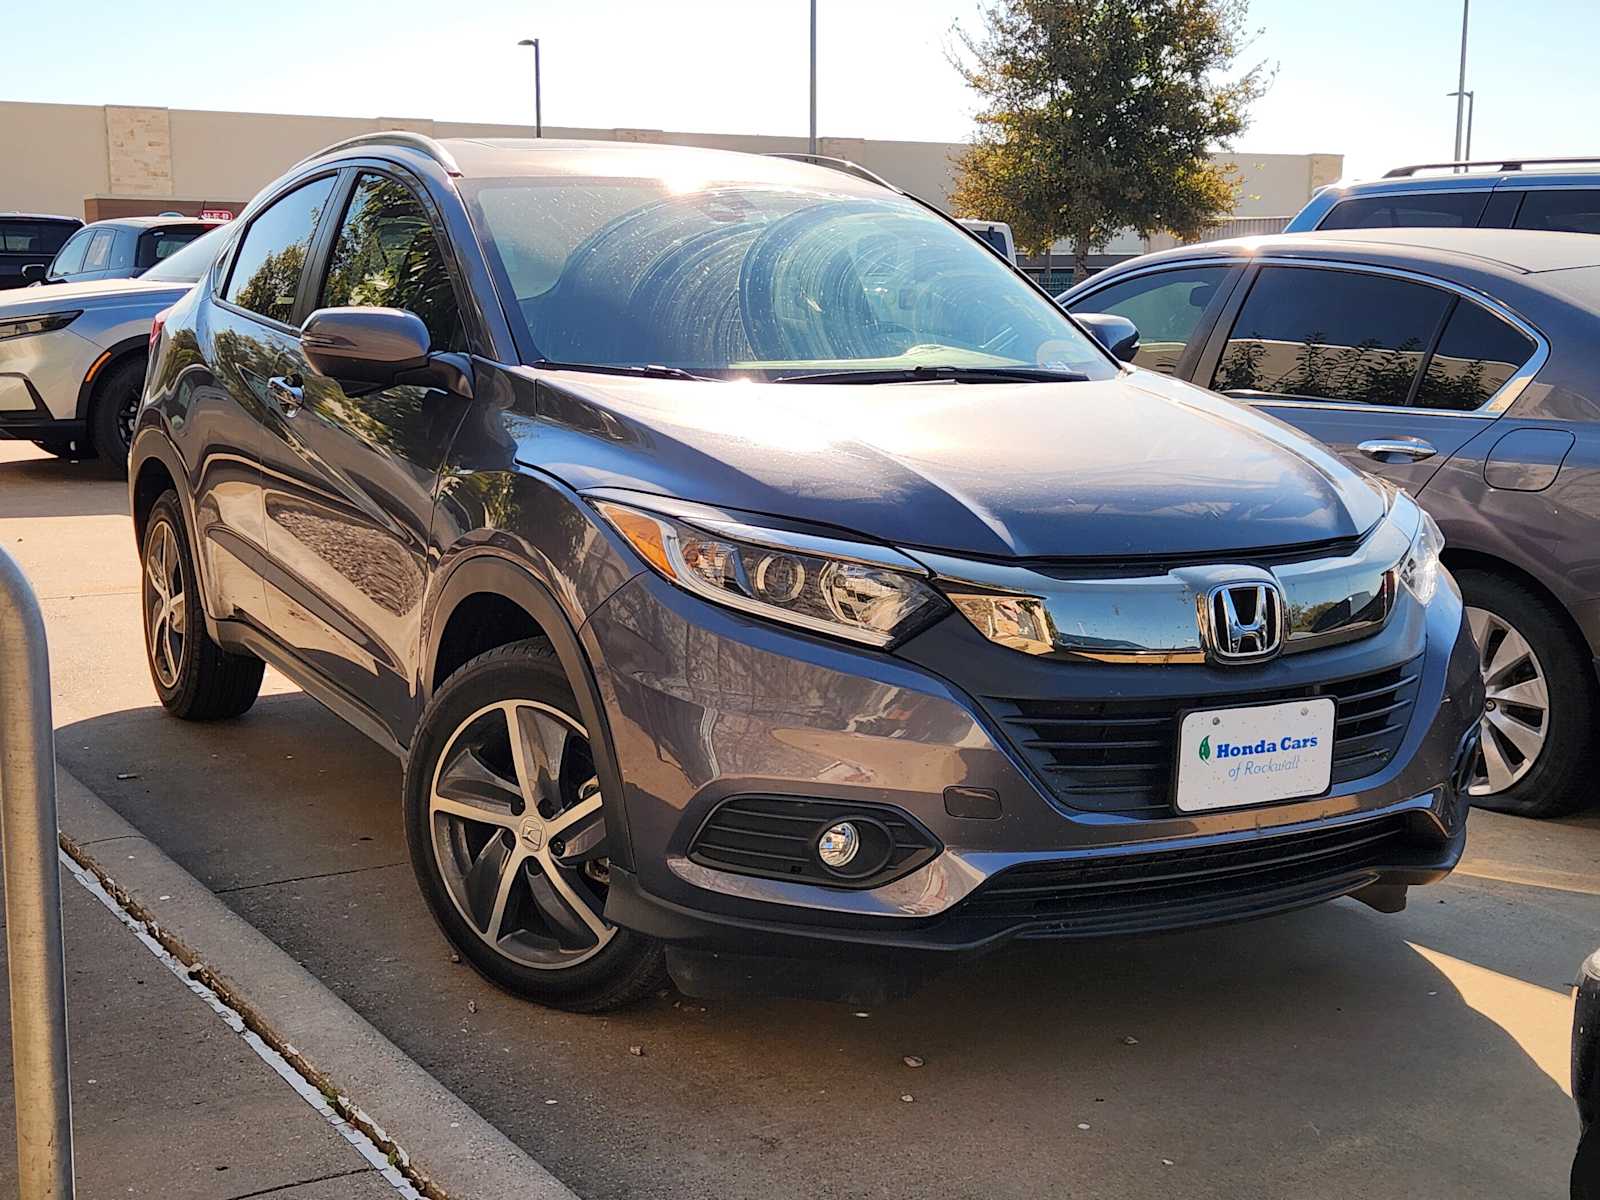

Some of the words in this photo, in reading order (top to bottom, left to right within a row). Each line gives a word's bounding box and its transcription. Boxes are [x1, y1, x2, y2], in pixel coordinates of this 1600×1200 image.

[1216, 740, 1277, 758] Honda
[1280, 736, 1318, 751] Cars
[1228, 762, 1242, 781] of
[1244, 756, 1300, 775] Rockwall
